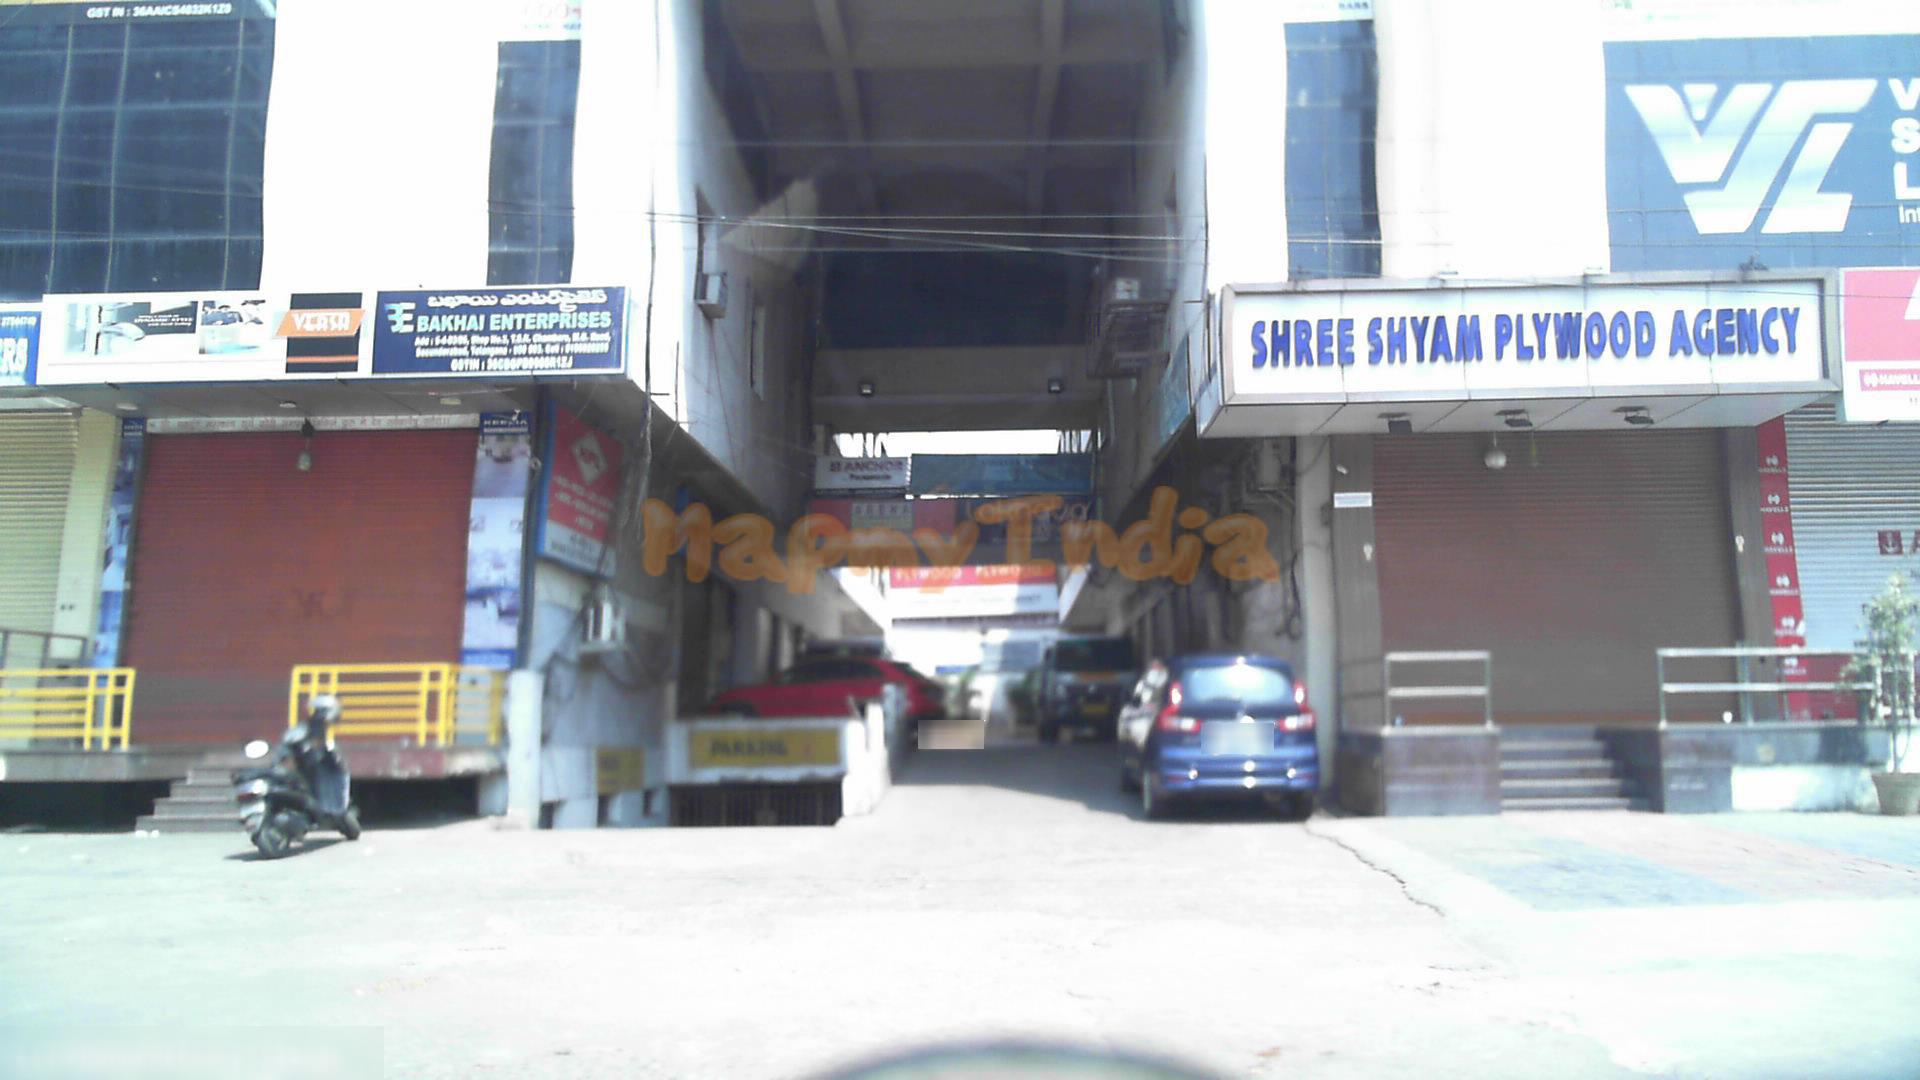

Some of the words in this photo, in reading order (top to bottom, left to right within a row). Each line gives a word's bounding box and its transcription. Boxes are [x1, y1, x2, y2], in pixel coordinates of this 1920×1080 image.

[86, 7, 111, 18] GST
[112, 7, 124, 17] IN
[417, 314, 486, 332] BAKHAI
[489, 311, 611, 331] ENTERPRISES
[1250, 317, 1355, 369] SHREE
[1366, 314, 1483, 366] SHYAM
[1494, 311, 1656, 362] PLYWOOD
[1668, 306, 1801, 358] AGENCY
